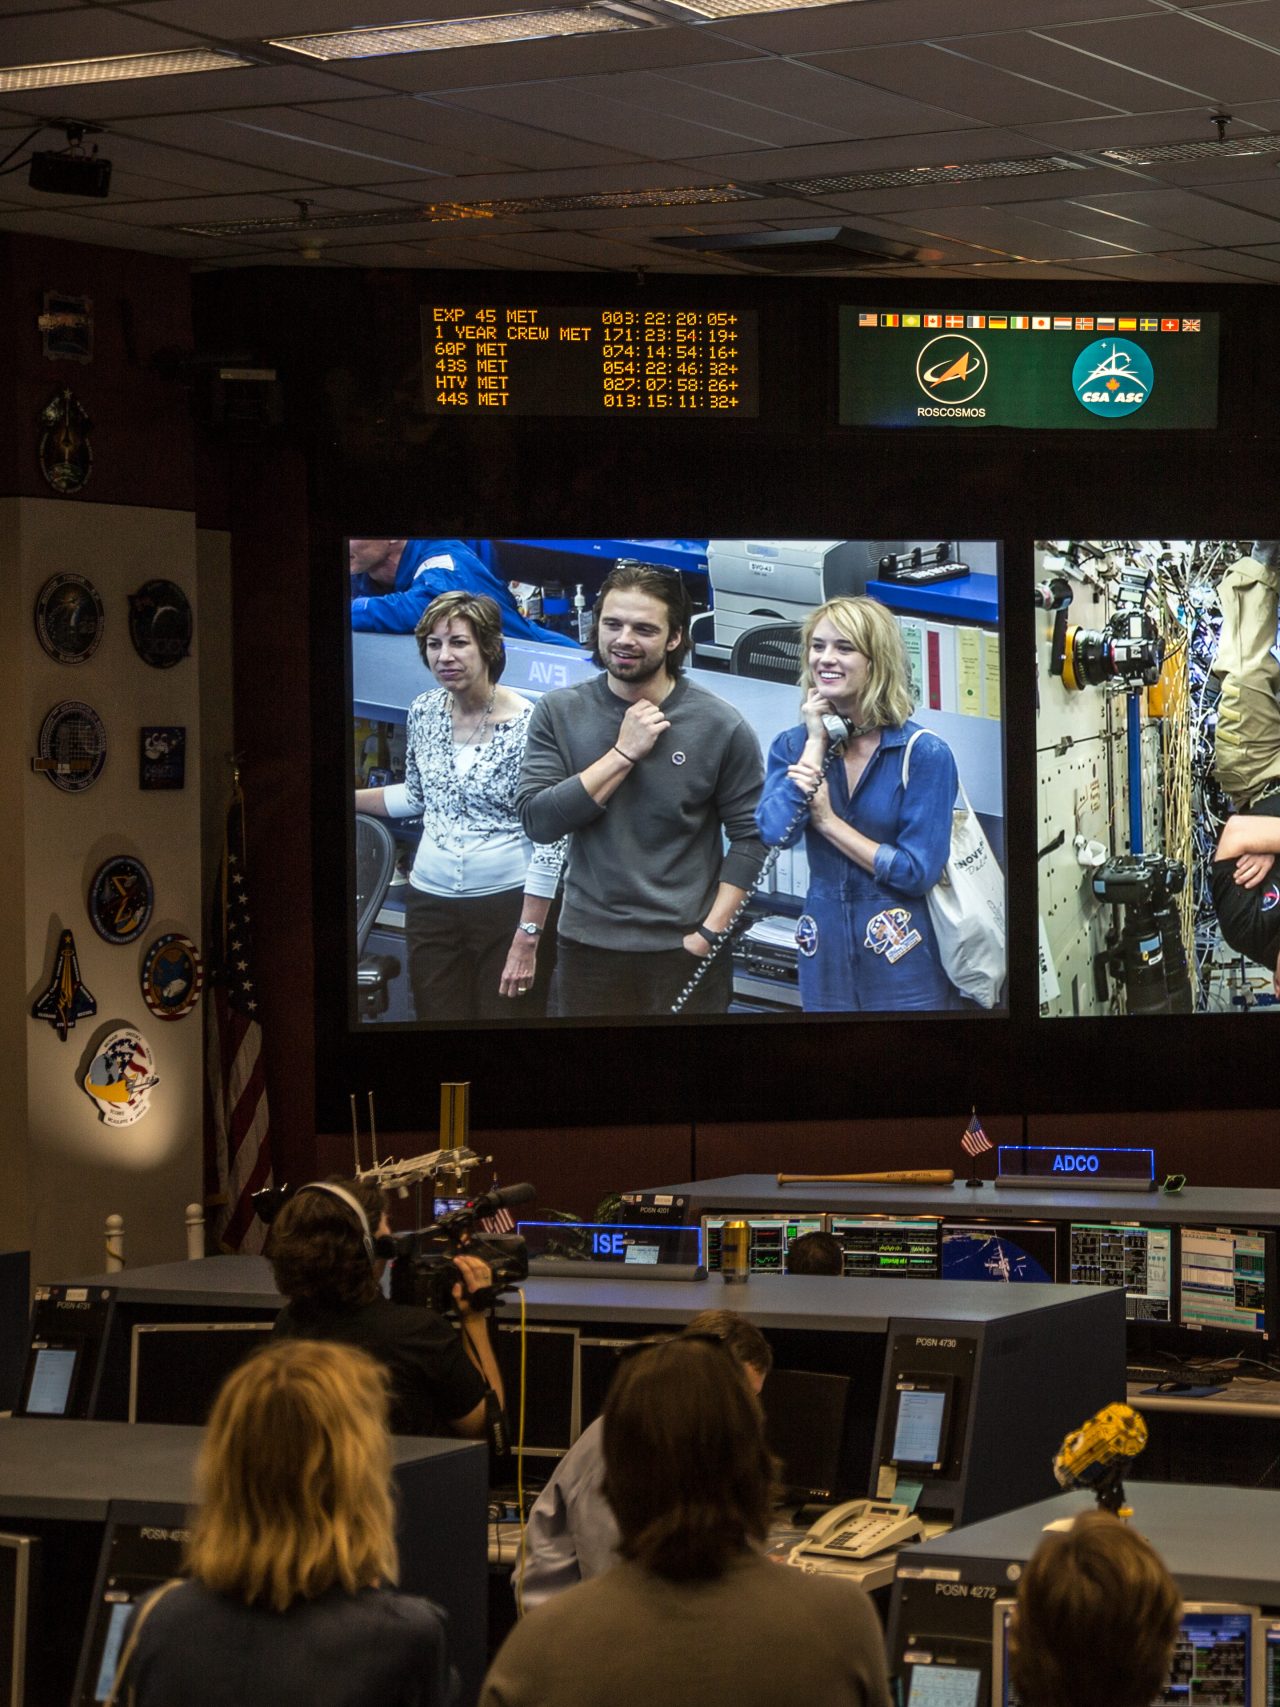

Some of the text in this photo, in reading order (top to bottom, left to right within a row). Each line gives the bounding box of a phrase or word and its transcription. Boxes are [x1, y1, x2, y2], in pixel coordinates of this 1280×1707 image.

[433, 308, 465, 323] EXP
[475, 309, 497, 323] 45
[506, 310, 538, 324] MET
[435, 326, 444, 339] 1
[455, 326, 497, 340] YEAR
[507, 327, 549, 340] CREW
[560, 328, 591, 341] MET
[434, 343, 466, 356] 60P
[476, 343, 508, 357] MET
[435, 359, 467, 373] 43S
[477, 359, 509, 373] MET
[436, 375, 468, 389] HTV
[478, 376, 509, 390] MET
[436, 392, 468, 405] 44S
[478, 393, 509, 406] MET
[1082, 392, 1143, 403] CSA ASC
[917, 407, 986, 418] ROSCOSMOS
[1052, 1155, 1099, 1172] ADCO
[593, 1232, 624, 1255] ISE
[916, 1337, 957, 1348] POSN 4730
[935, 1583, 998, 1600] POSN 4272
